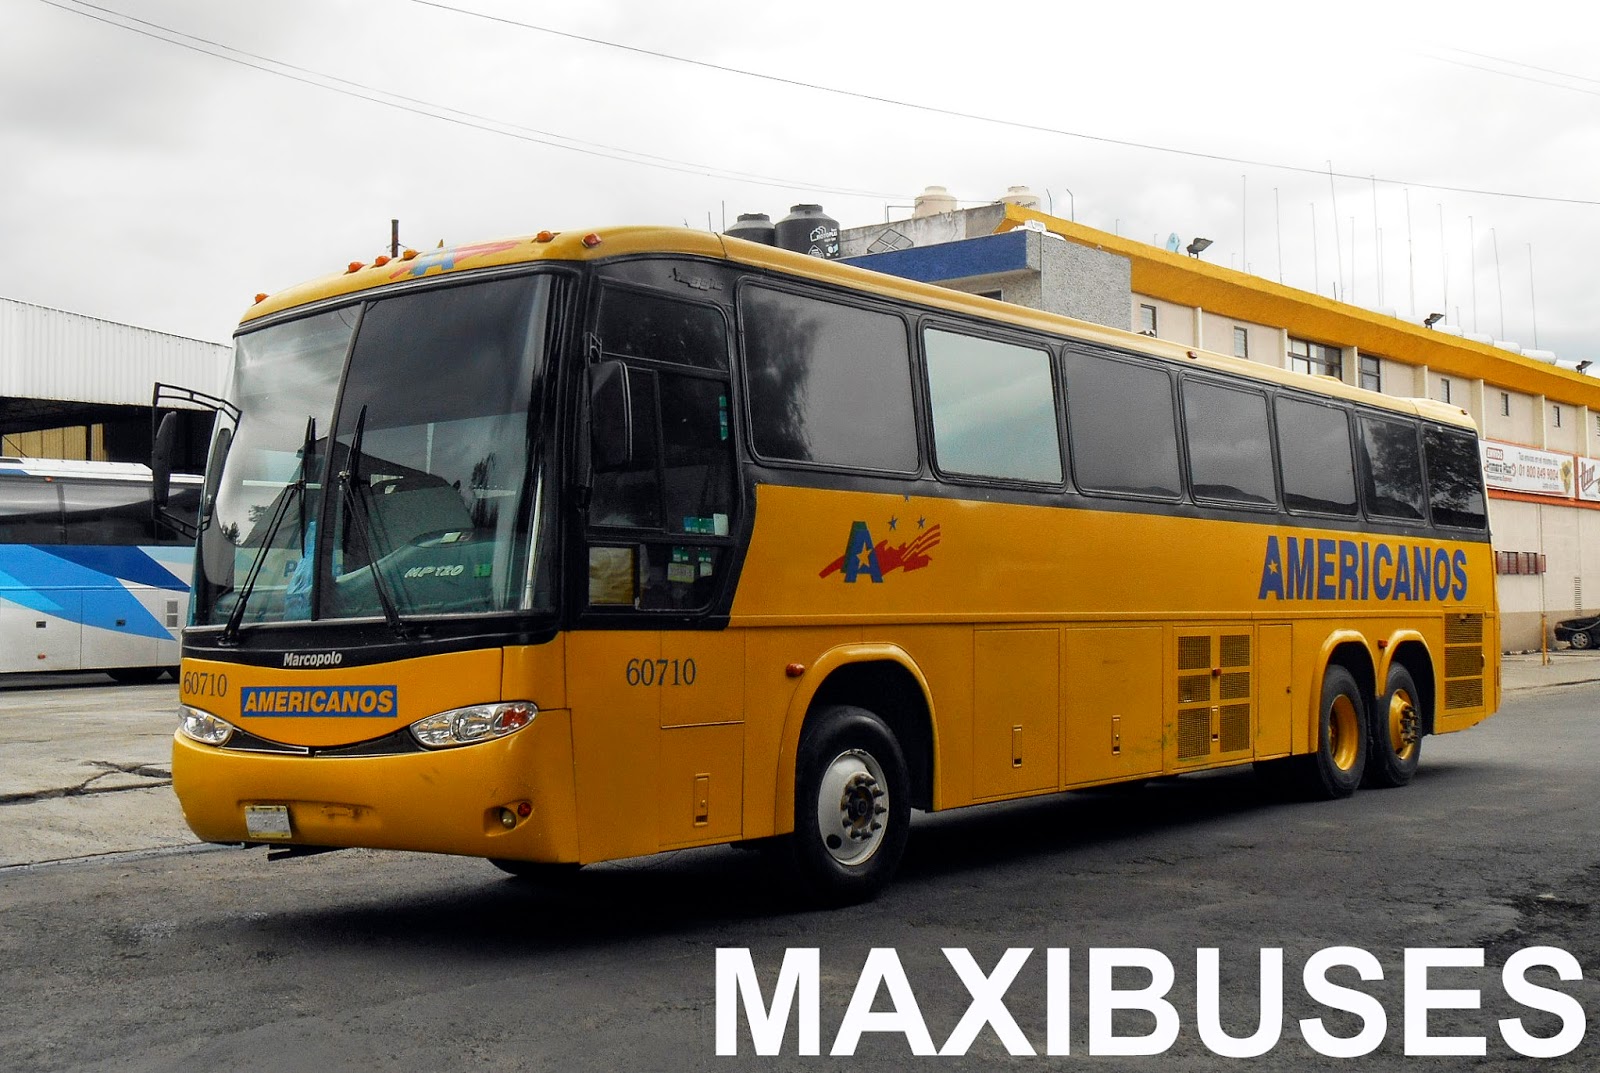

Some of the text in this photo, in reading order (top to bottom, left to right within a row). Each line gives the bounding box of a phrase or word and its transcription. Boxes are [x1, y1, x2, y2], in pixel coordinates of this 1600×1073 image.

[1258, 535, 1467, 601] AMERICANOS
[283, 651, 342, 667] Marcopolo
[626, 658, 697, 686] 60710
[184, 671, 227, 697] 60710
[243, 690, 393, 713] AMERICANOS
